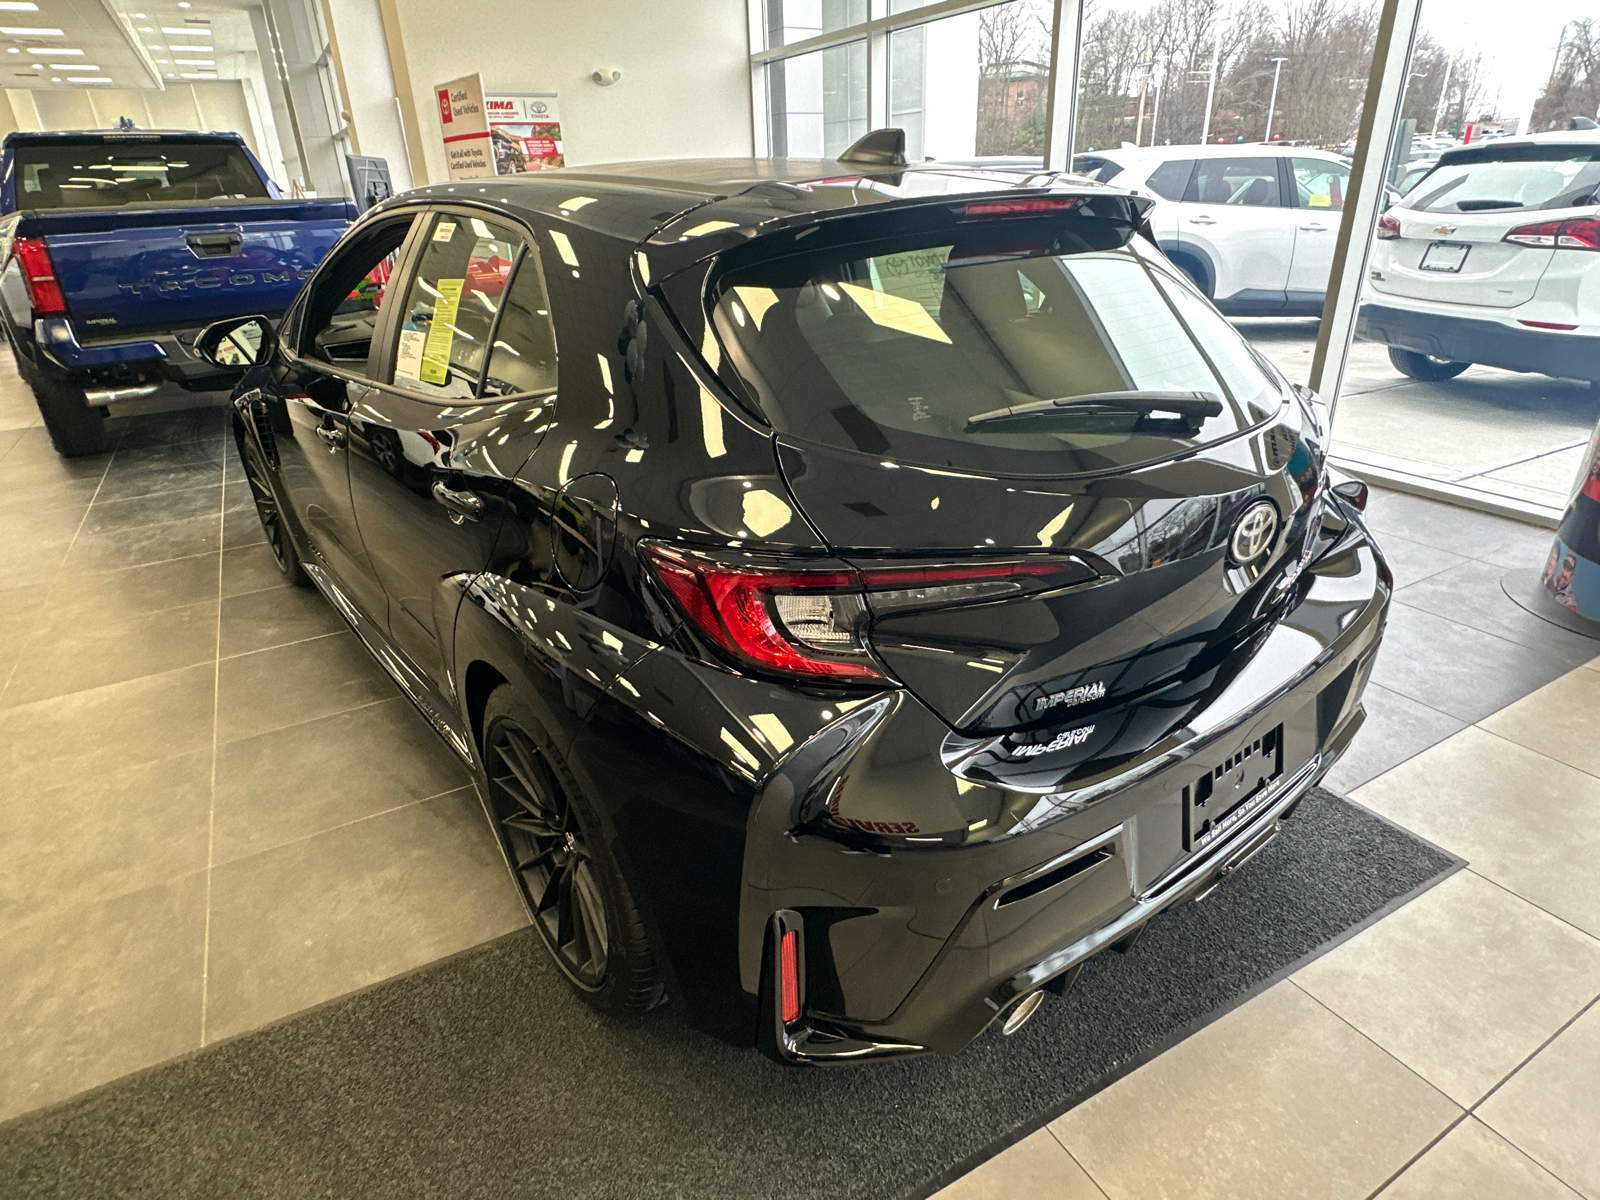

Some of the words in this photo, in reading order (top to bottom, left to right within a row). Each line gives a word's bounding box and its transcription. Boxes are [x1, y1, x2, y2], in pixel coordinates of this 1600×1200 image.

[451, 91, 467, 102] Certified
[453, 107, 463, 117] Used
[463, 103, 479, 114] Vehicles
[907, 253, 947, 267] TOYOT
[1035, 681, 1106, 711] IMPERIAL
[1200, 835, 1211, 845] We
[1211, 825, 1222, 838] Sell
[1237, 807, 1245, 817] So
[1245, 800, 1255, 811] You
[1255, 790, 1267, 803] Save
[1267, 780, 1280, 793] More
